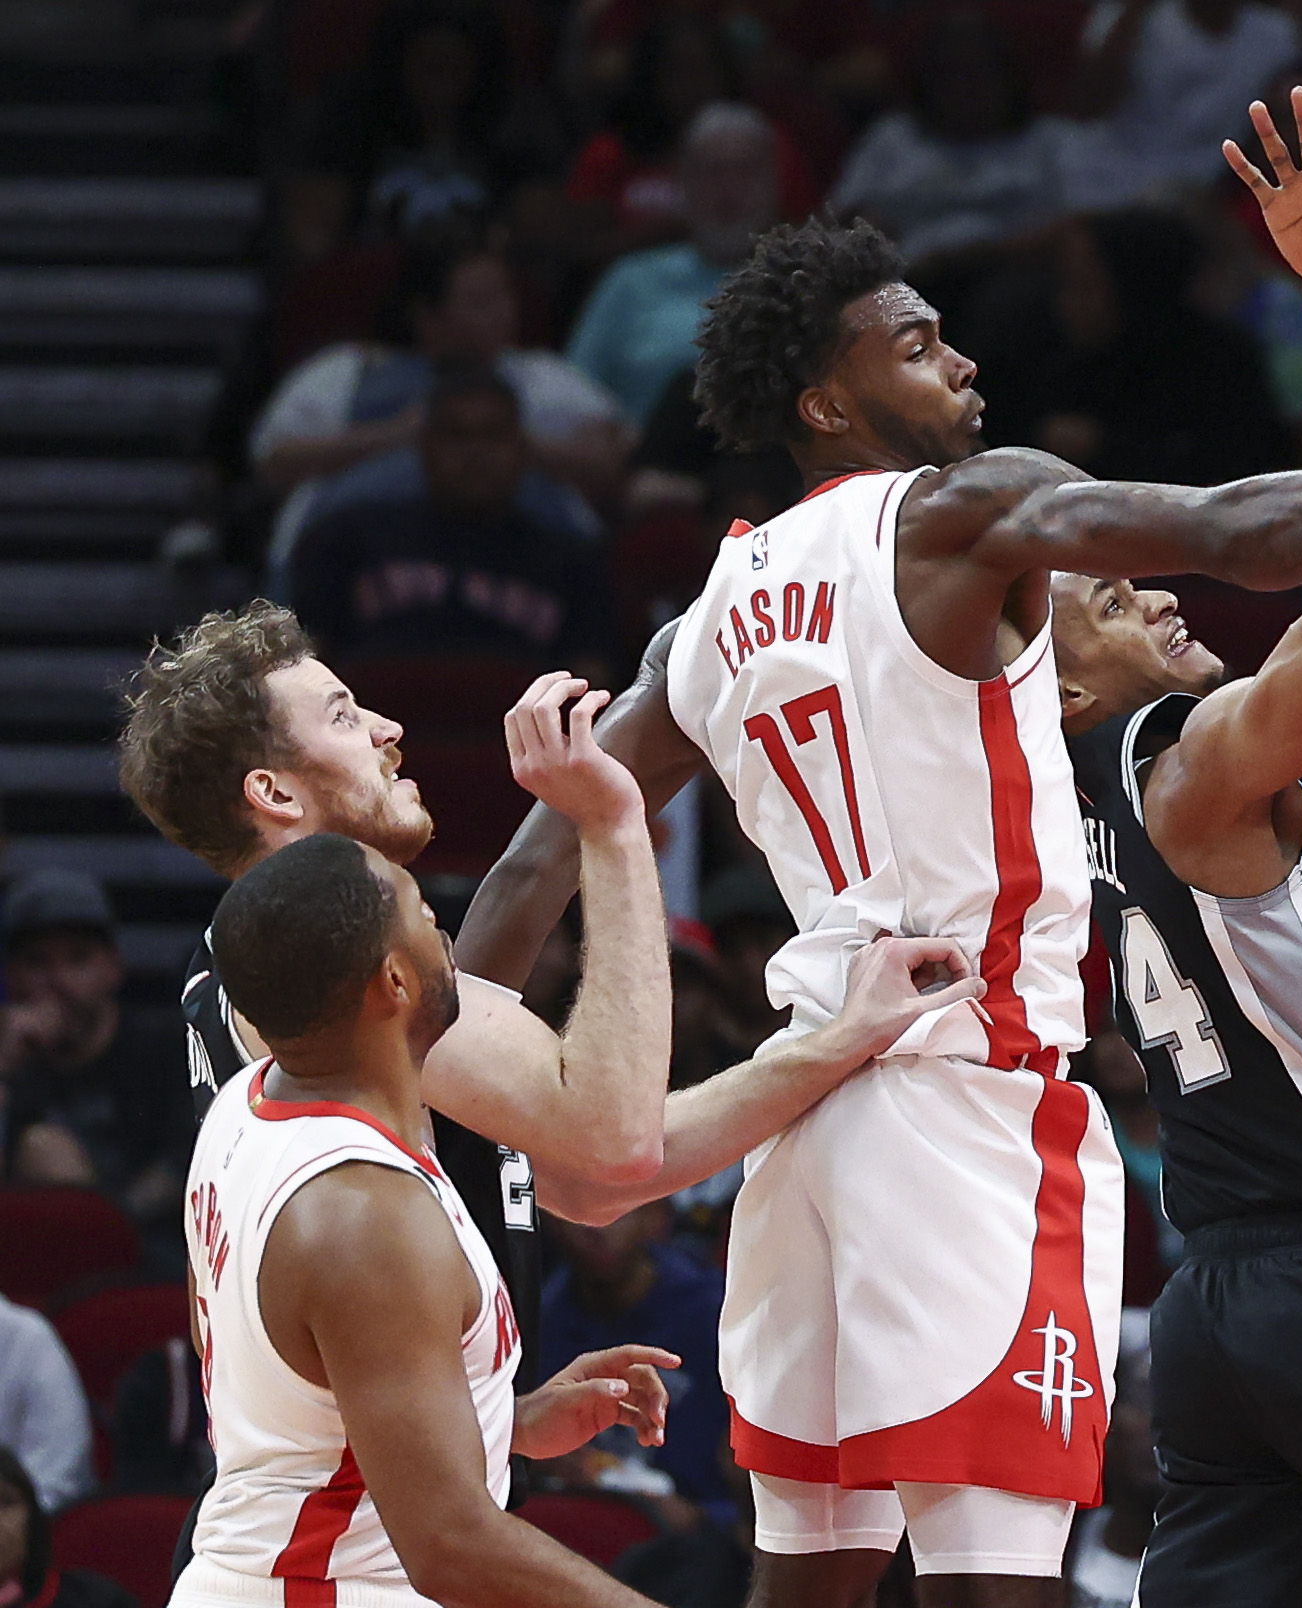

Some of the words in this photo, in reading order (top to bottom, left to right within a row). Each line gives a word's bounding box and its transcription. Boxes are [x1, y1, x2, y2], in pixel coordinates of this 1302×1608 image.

[715, 580, 837, 681] EASON
[743, 683, 872, 897] 17
[1083, 816, 1127, 895] SELL
[1120, 906, 1233, 1096] 4
[498, 1144, 536, 1232] 2
